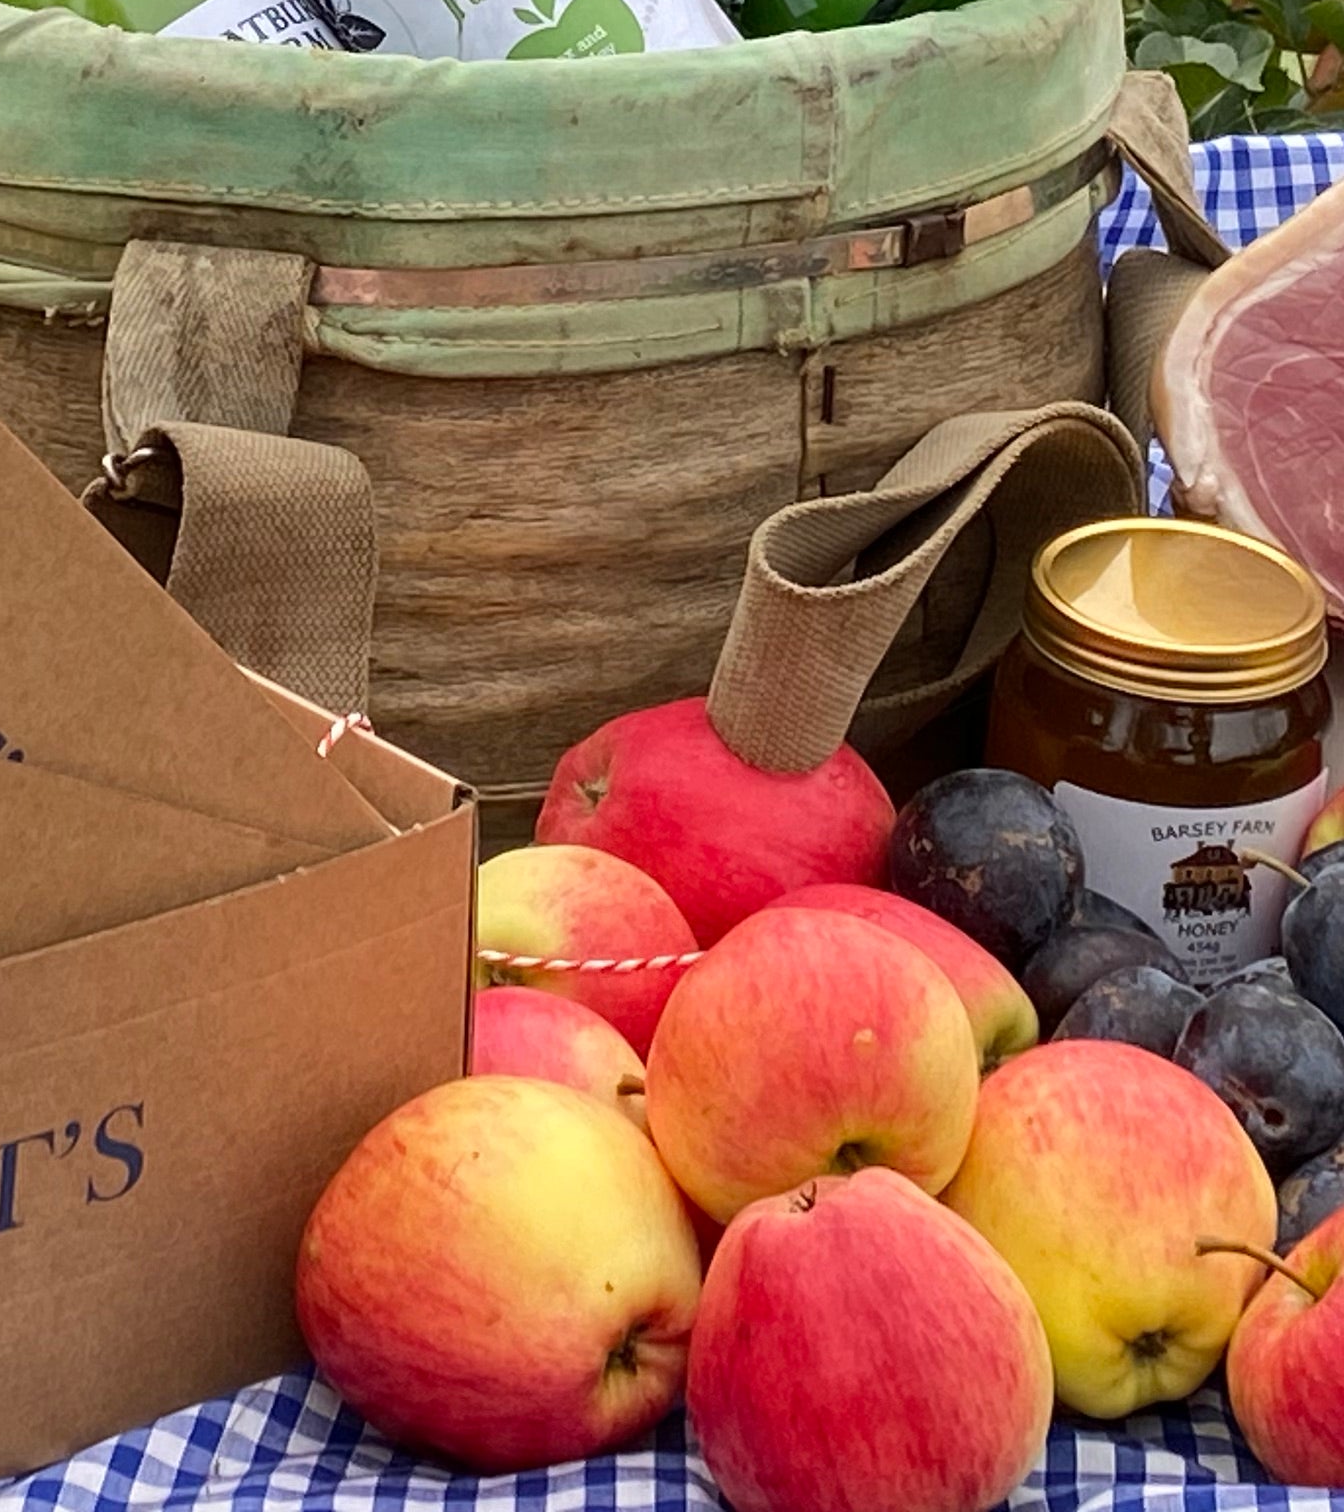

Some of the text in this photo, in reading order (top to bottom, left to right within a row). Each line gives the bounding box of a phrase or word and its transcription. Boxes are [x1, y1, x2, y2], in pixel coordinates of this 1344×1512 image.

[576, 24, 609, 52] and
[1151, 820, 1228, 842] BARSEY
[1177, 919, 1239, 938] HONEY
